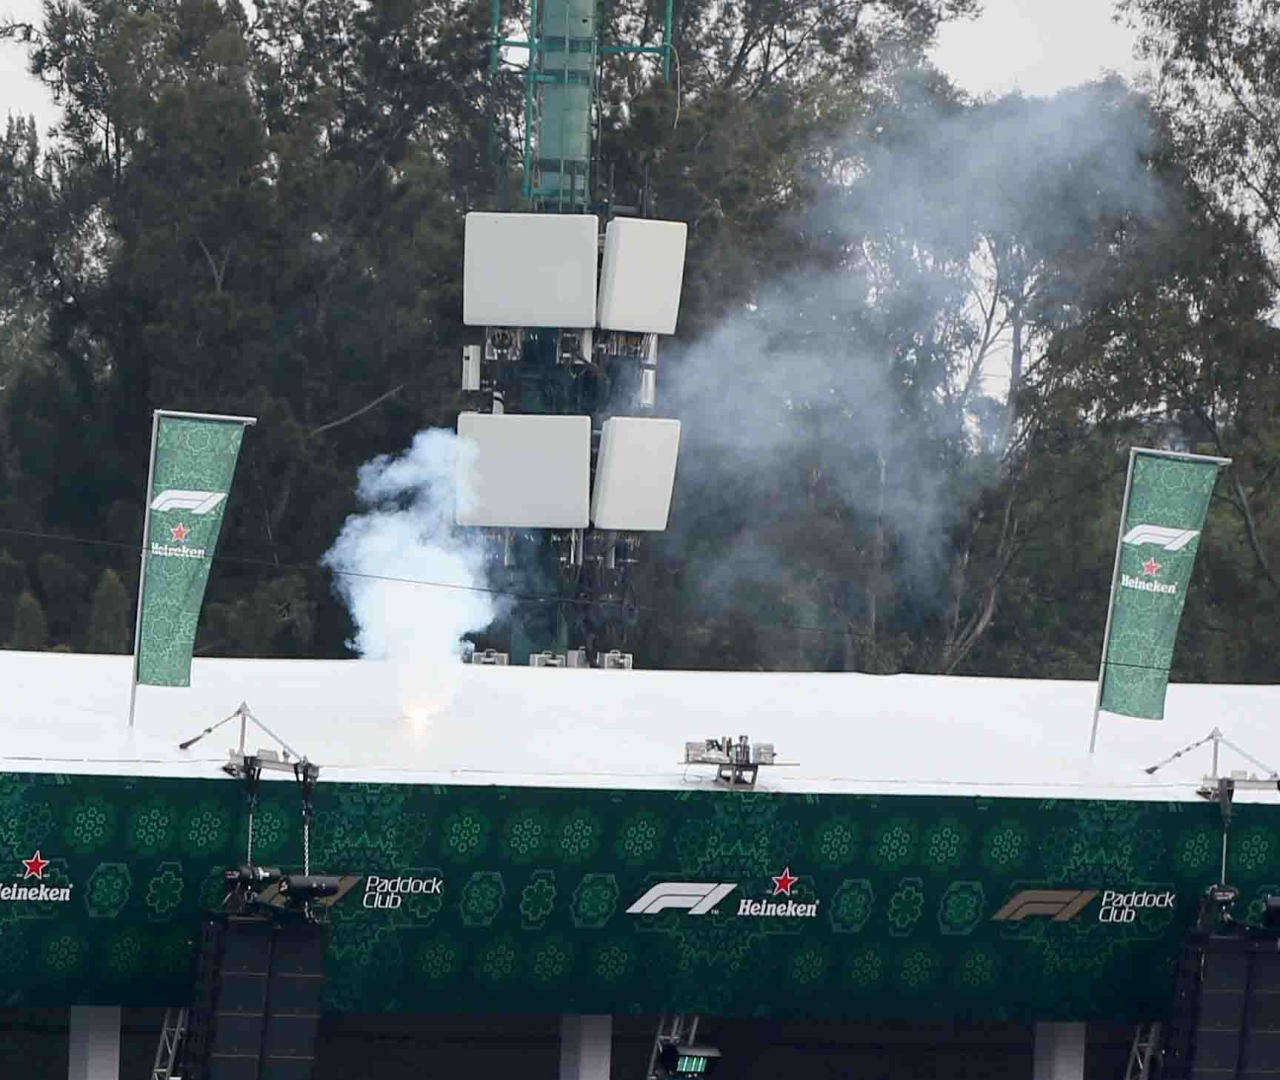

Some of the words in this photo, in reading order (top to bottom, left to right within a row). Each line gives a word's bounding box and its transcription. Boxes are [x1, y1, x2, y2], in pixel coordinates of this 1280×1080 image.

[1121, 574, 1176, 594] Heineken
[365, 876, 443, 894] Paddock
[363, 892, 402, 909] Club
[737, 899, 817, 917] Heineken
[1101, 890, 1175, 908] Paddock
[1099, 906, 1136, 923] Club
